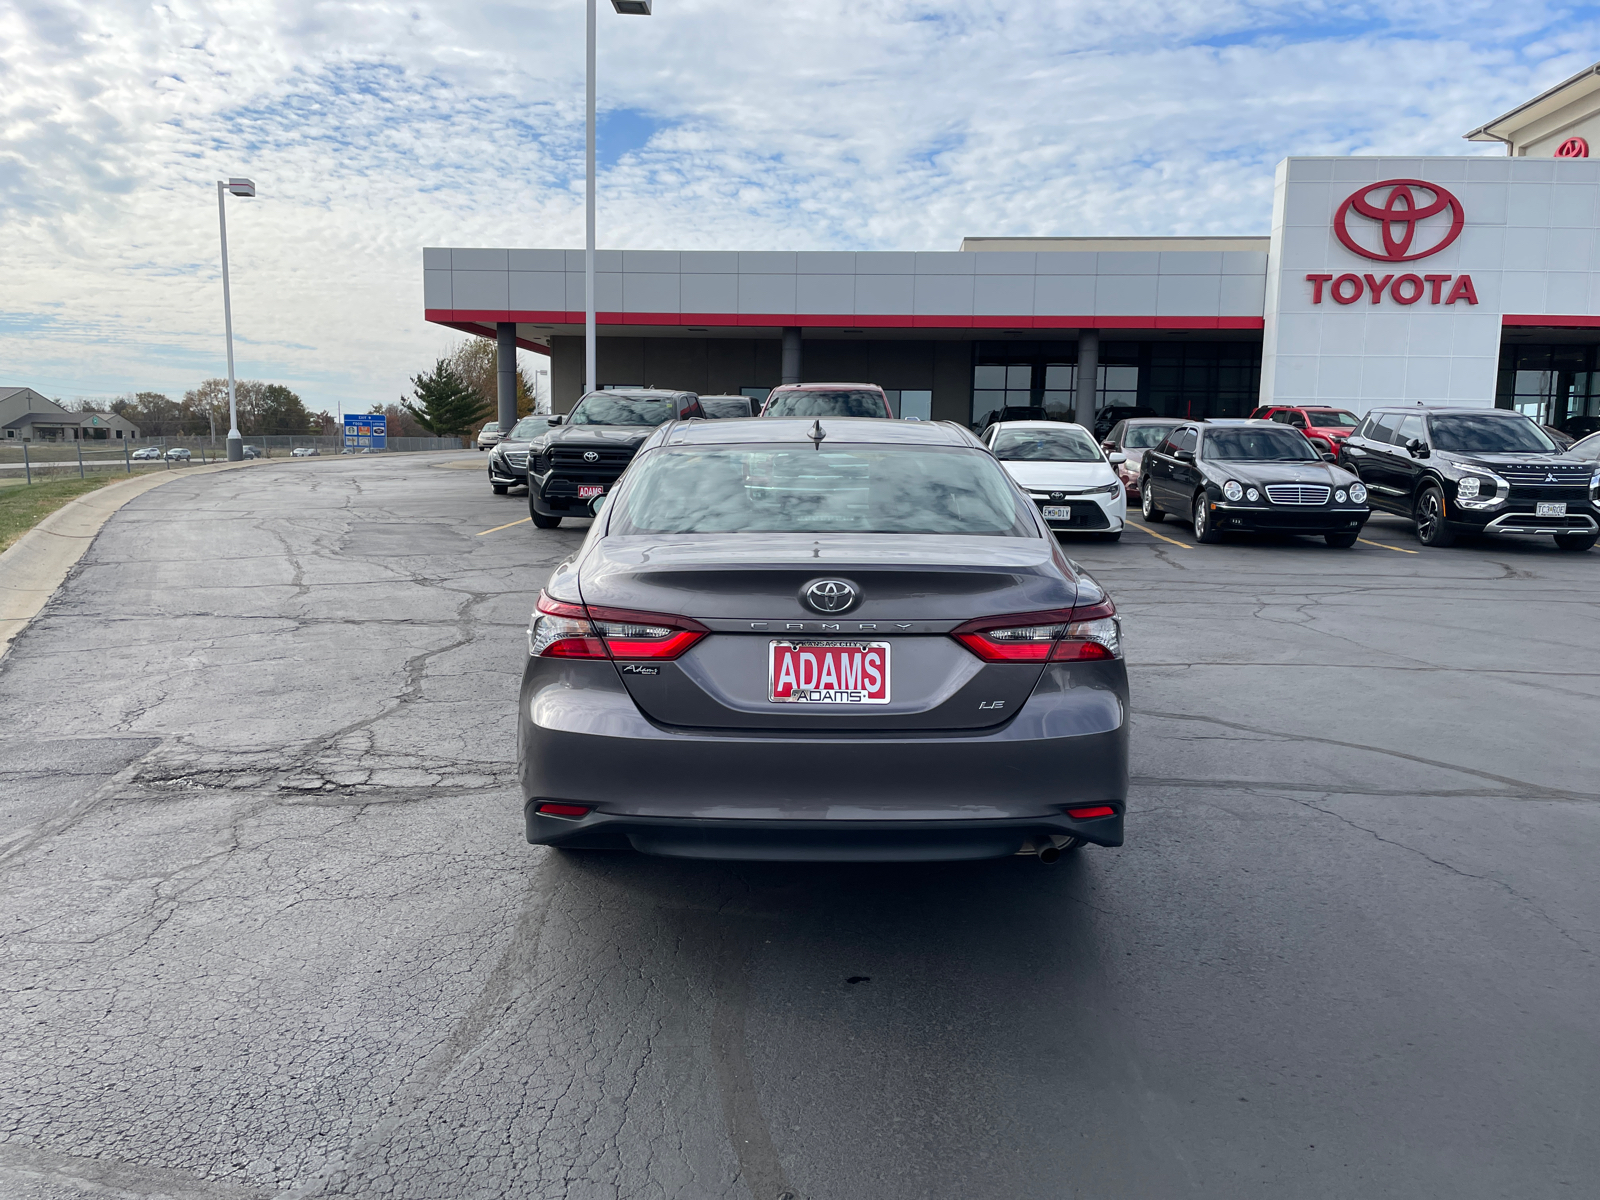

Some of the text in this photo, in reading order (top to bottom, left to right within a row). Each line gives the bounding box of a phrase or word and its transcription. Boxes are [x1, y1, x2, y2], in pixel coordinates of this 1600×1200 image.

[1305, 273, 1479, 305] TOYOTA
[580, 487, 602, 497] ADAMS
[750, 622, 913, 631] CAMRY
[776, 652, 882, 693] ADAMS
[797, 690, 862, 702] ADAMS
[978, 701, 1006, 710] LE
